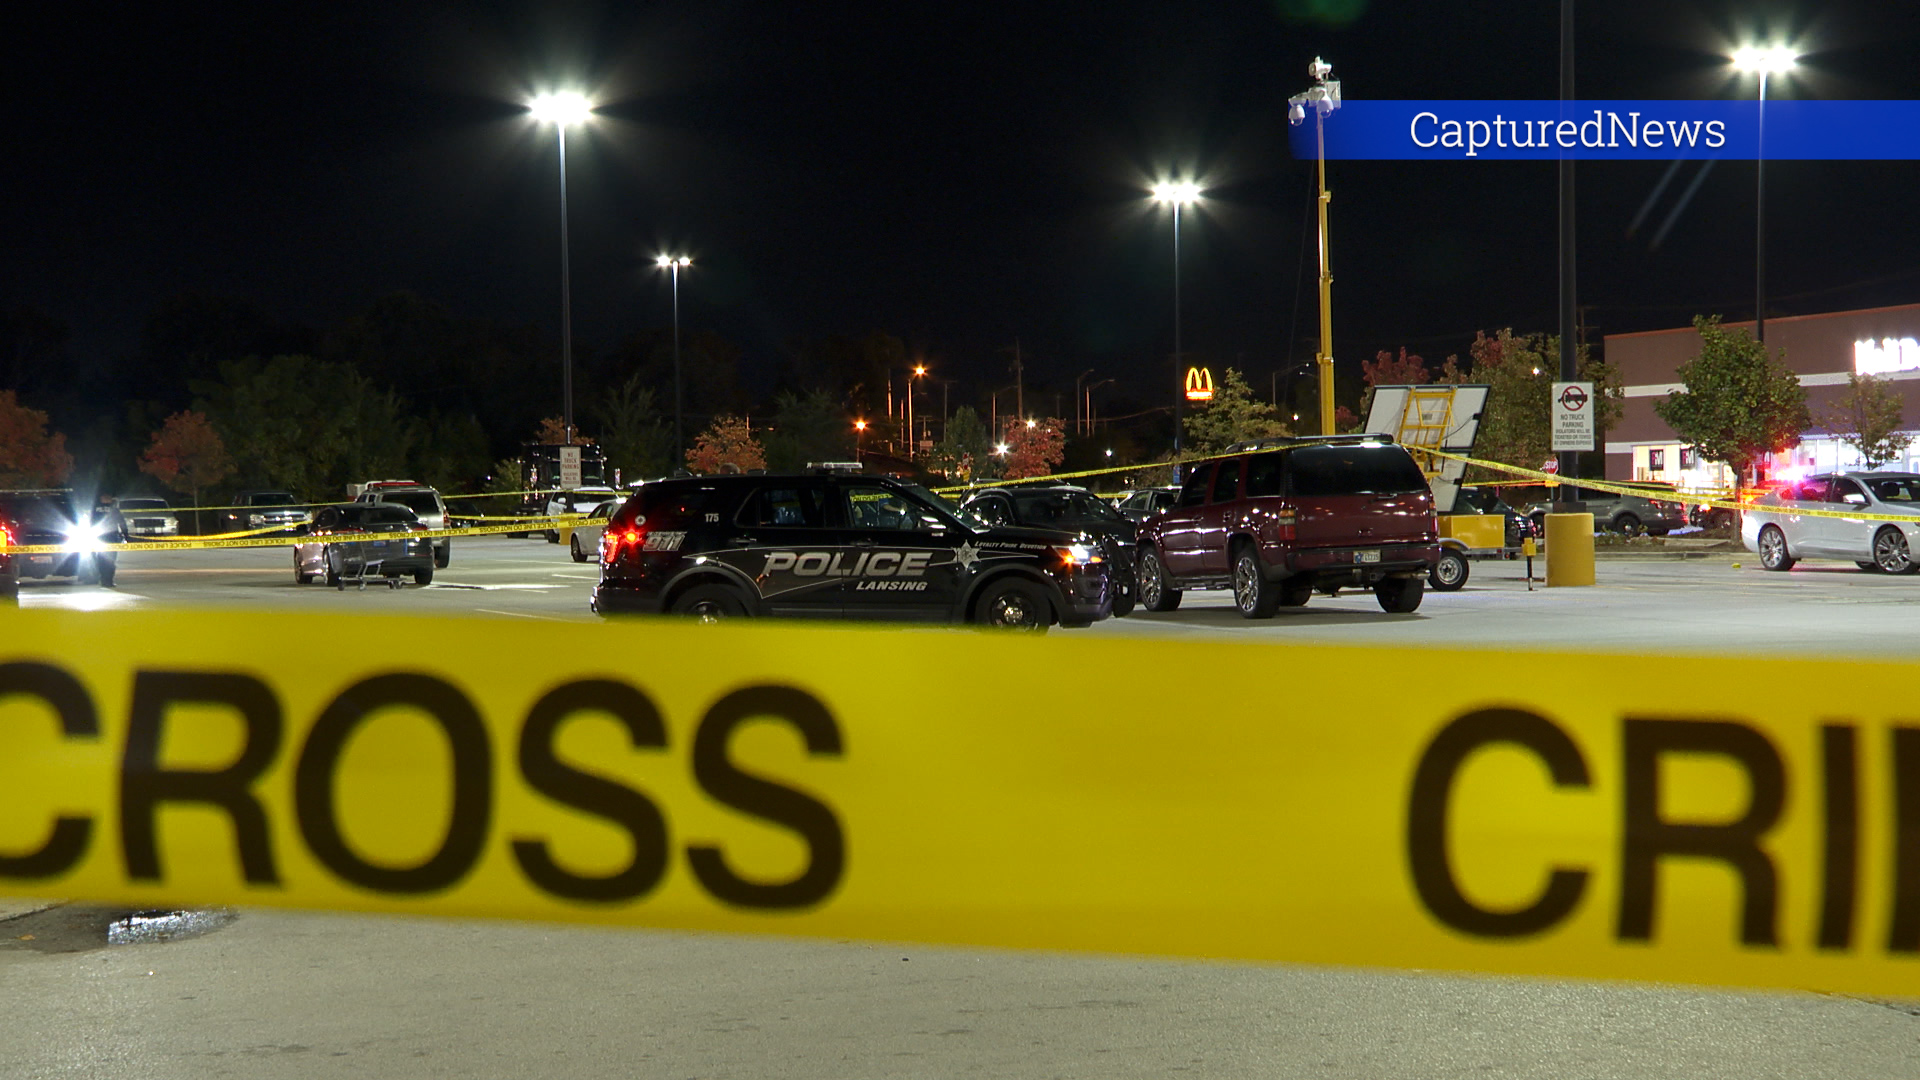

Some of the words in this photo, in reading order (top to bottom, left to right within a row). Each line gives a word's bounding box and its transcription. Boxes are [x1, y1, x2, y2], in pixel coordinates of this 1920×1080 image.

[1545, 461, 1558, 469] STOP
[705, 513, 719, 522] 175
[643, 535, 686, 552] 911
[763, 552, 932, 577] POLICE
[856, 581, 928, 591] LANSING
[1405, 704, 1920, 955] CRI
